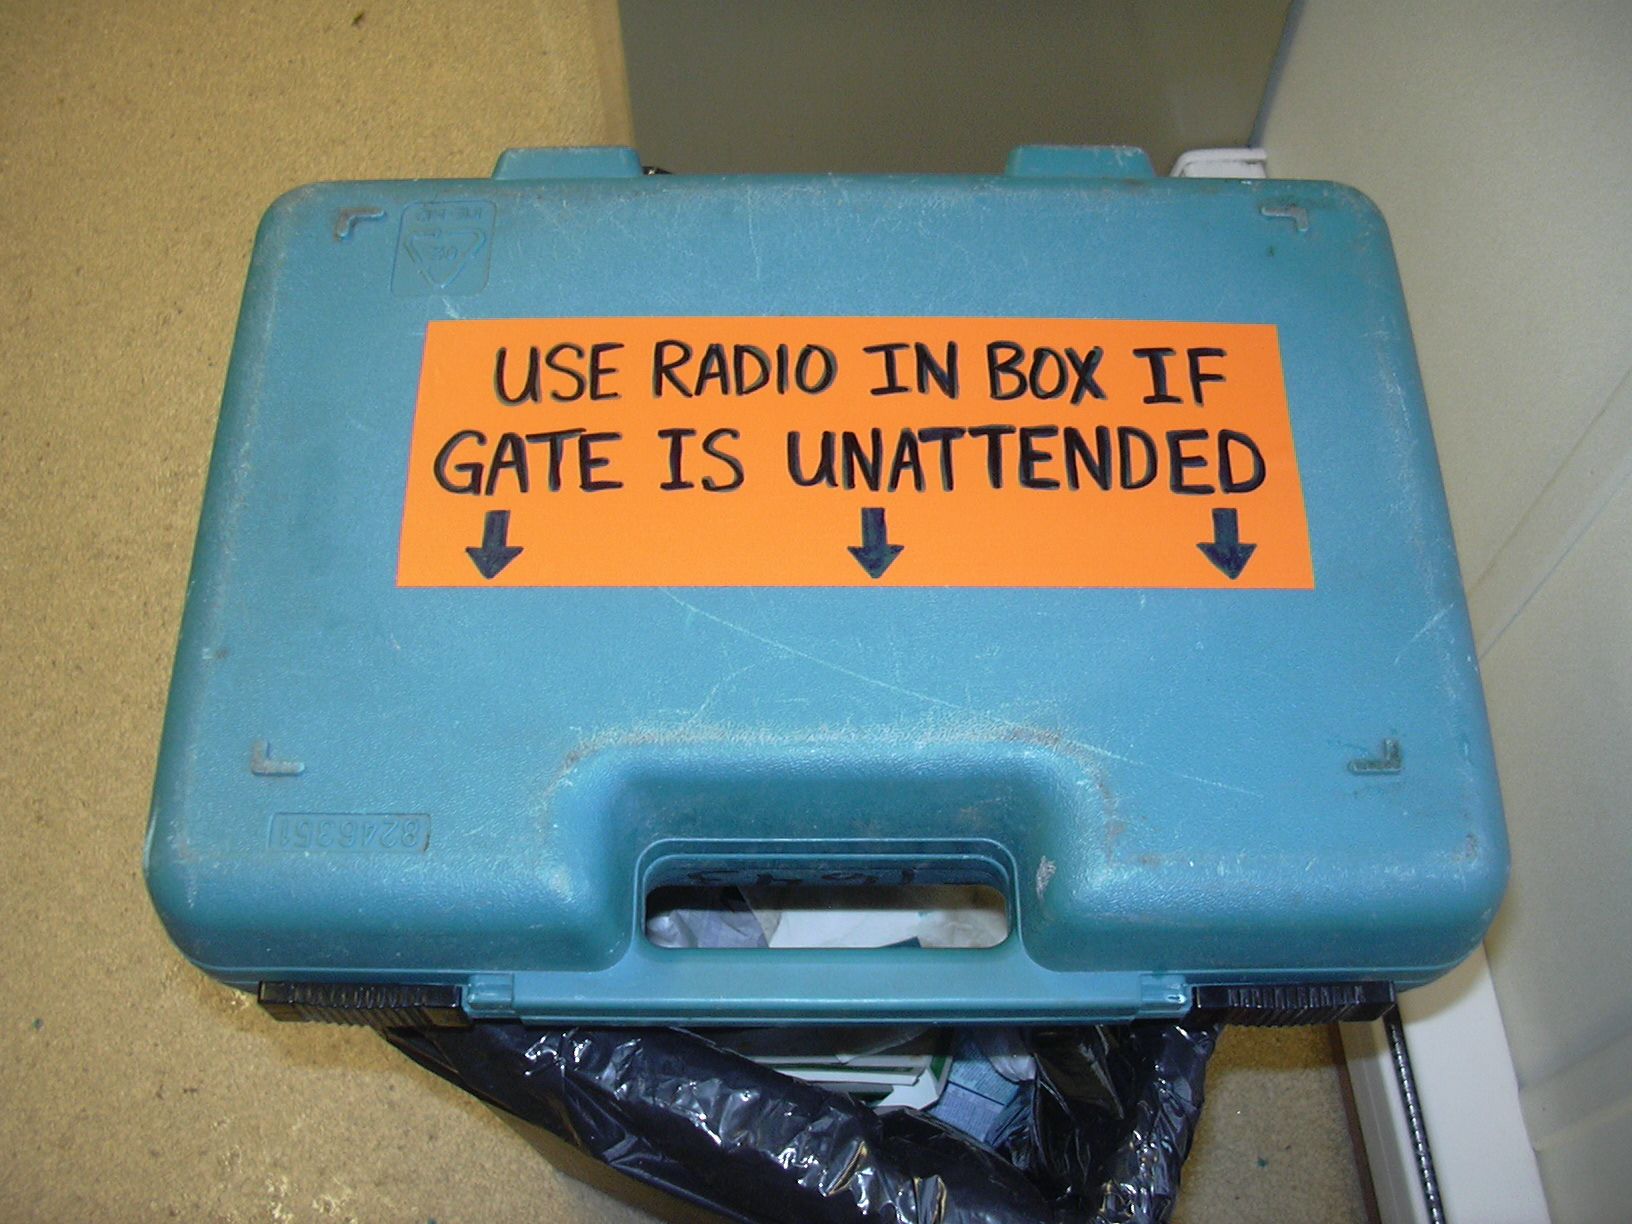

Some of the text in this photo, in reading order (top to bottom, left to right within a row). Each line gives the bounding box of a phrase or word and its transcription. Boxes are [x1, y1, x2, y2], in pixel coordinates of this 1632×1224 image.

[494, 339, 1230, 406] USE RADIO IN BOX IF
[433, 424, 1267, 497] GATE IS UNATTENDED
[278, 817, 421, 849] 8246351
